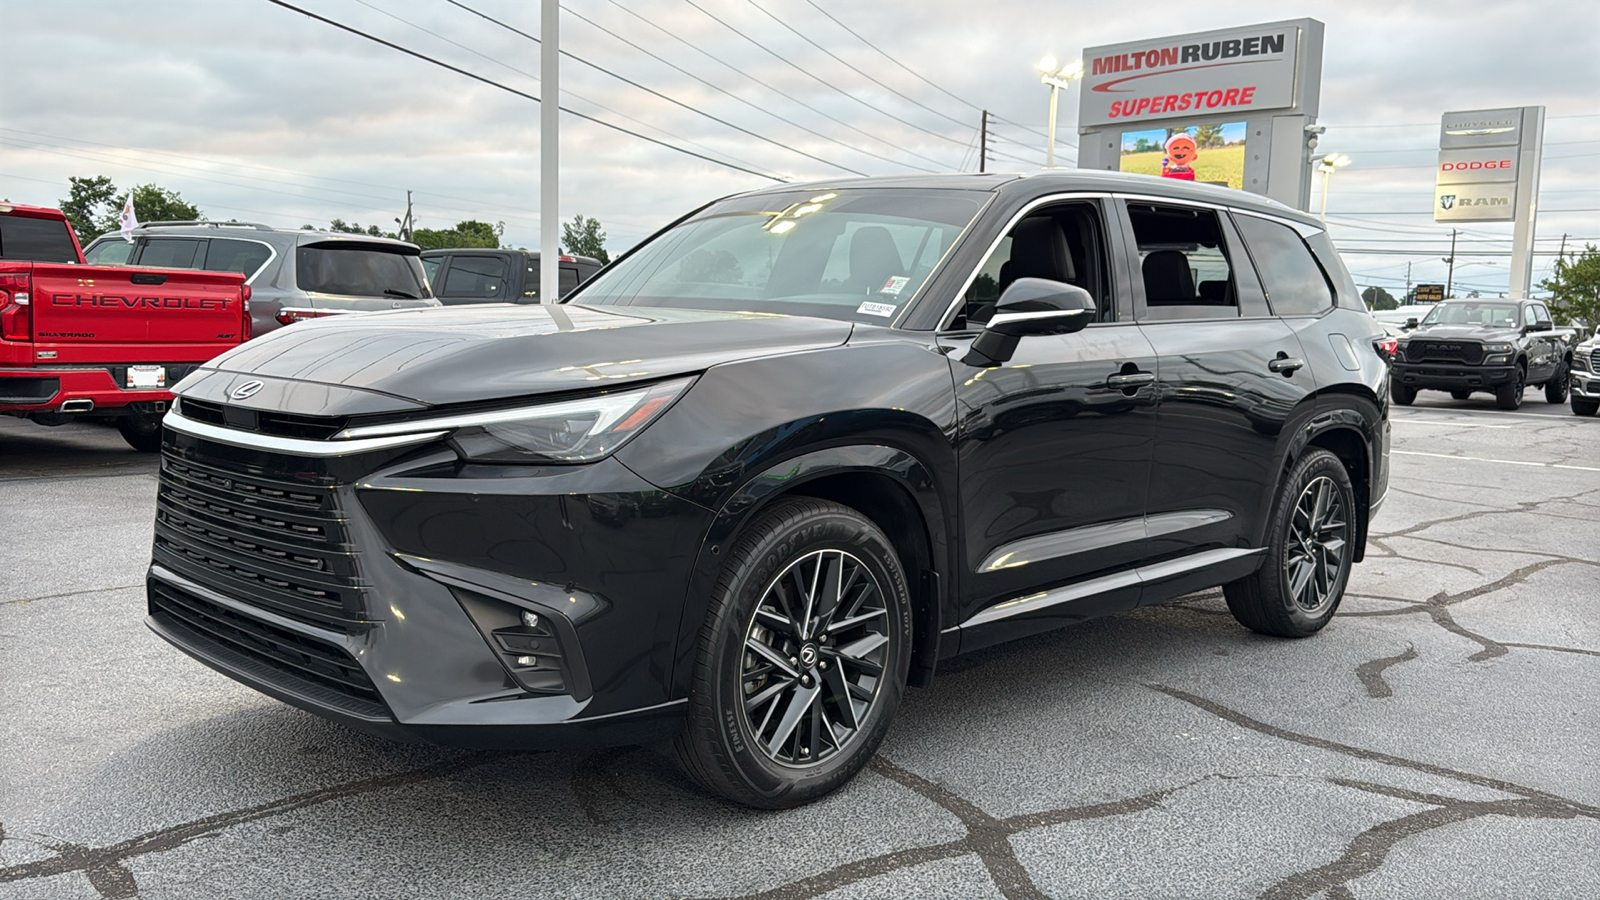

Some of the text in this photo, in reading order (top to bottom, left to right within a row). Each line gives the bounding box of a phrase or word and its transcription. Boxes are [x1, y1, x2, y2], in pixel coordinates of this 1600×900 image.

[1092, 34, 1285, 75] MILTON RUBEN
[1108, 86, 1256, 118] SUPERSTORE
[1446, 120, 1514, 129] CHRYSLER
[1442, 160, 1512, 171] DODGE
[1458, 197, 1508, 206] RAM
[52, 294, 233, 310] CHEVROLET
[726, 708, 745, 753] FINESSE
